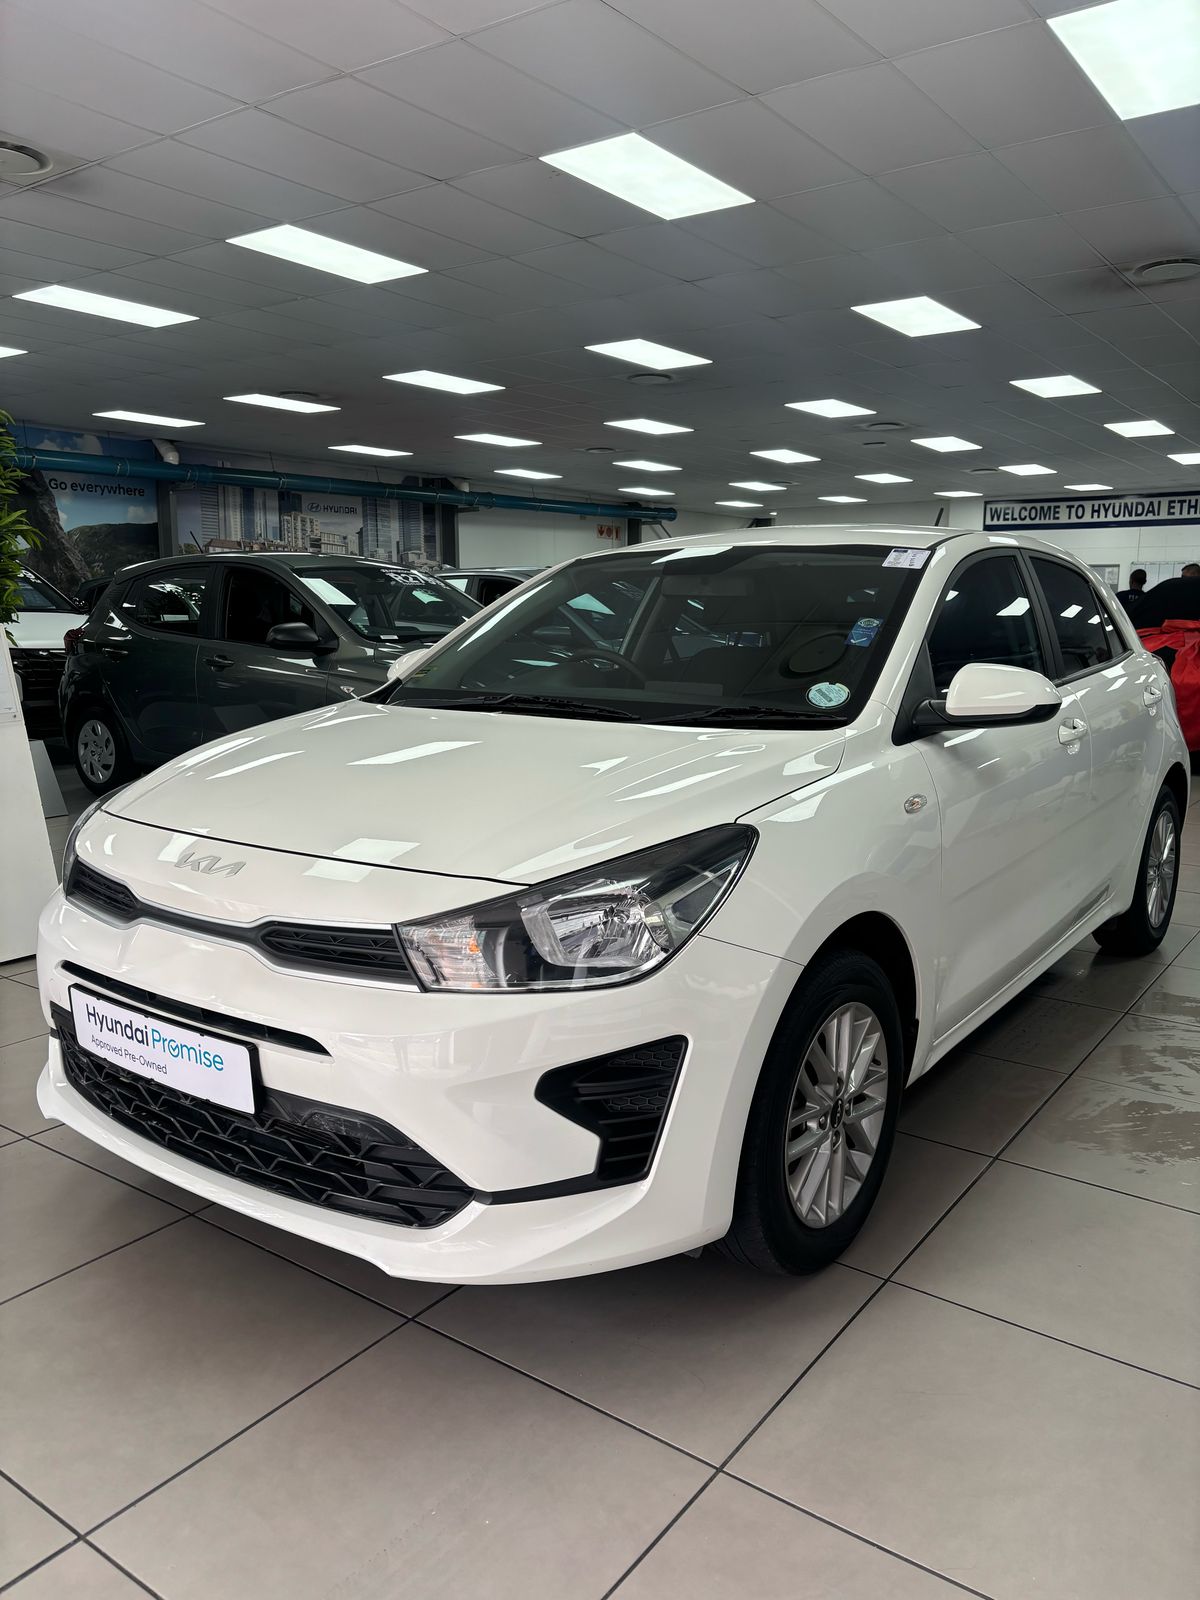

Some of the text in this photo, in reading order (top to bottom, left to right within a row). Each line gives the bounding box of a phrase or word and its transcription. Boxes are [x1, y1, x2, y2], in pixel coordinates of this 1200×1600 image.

[48, 478, 145, 497] Go everywhere
[323, 504, 358, 514] HYUNDAI
[989, 498, 1200, 522] WELCOME TO HYUNDAI ETH
[86, 1003, 149, 1047] Hyundai
[91, 1034, 168, 1075] Approved Pre-Owned
